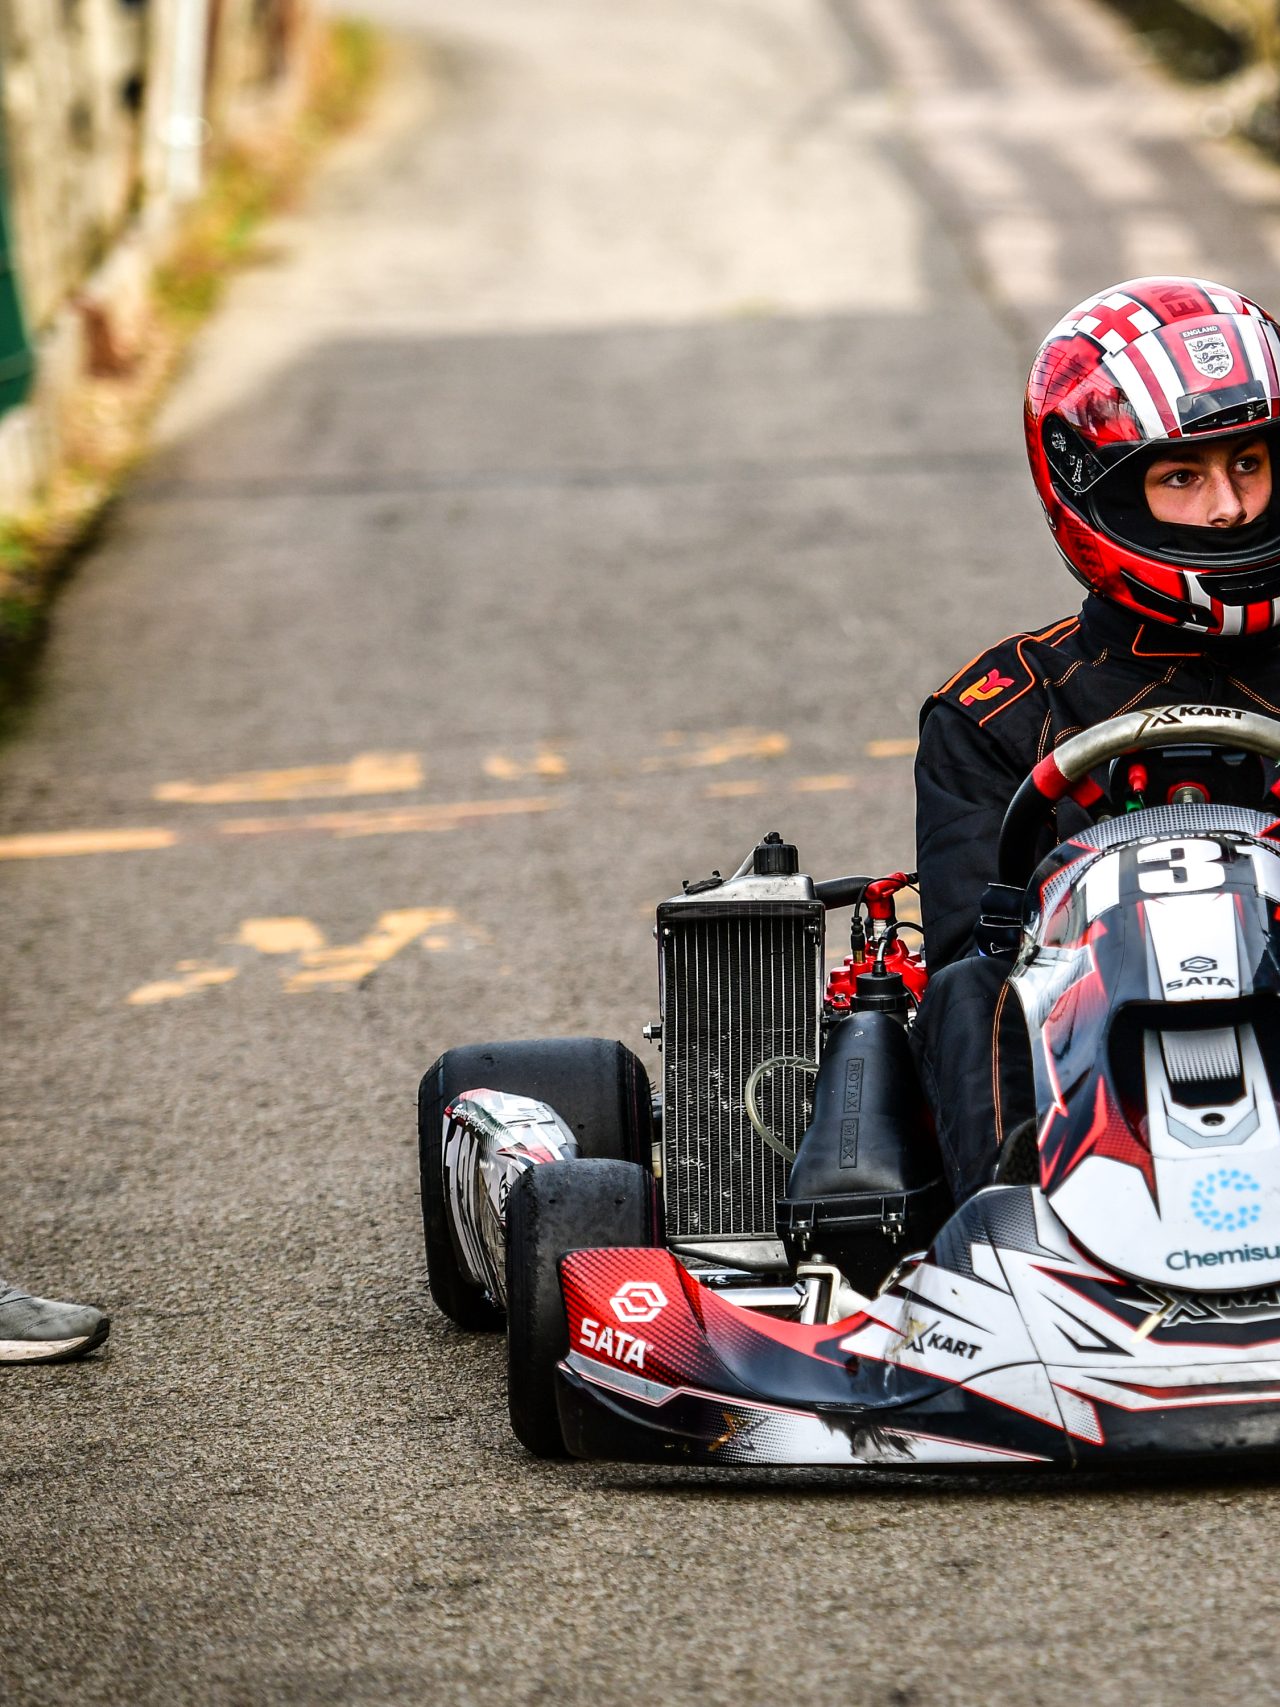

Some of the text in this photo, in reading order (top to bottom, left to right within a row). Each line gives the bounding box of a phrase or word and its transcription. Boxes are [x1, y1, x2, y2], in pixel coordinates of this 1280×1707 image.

[1181, 325, 1219, 338] ENGLAND
[1166, 975, 1236, 993] SATA
[842, 1062, 861, 1161] ROTAX MAX
[579, 1317, 647, 1370] SATA
